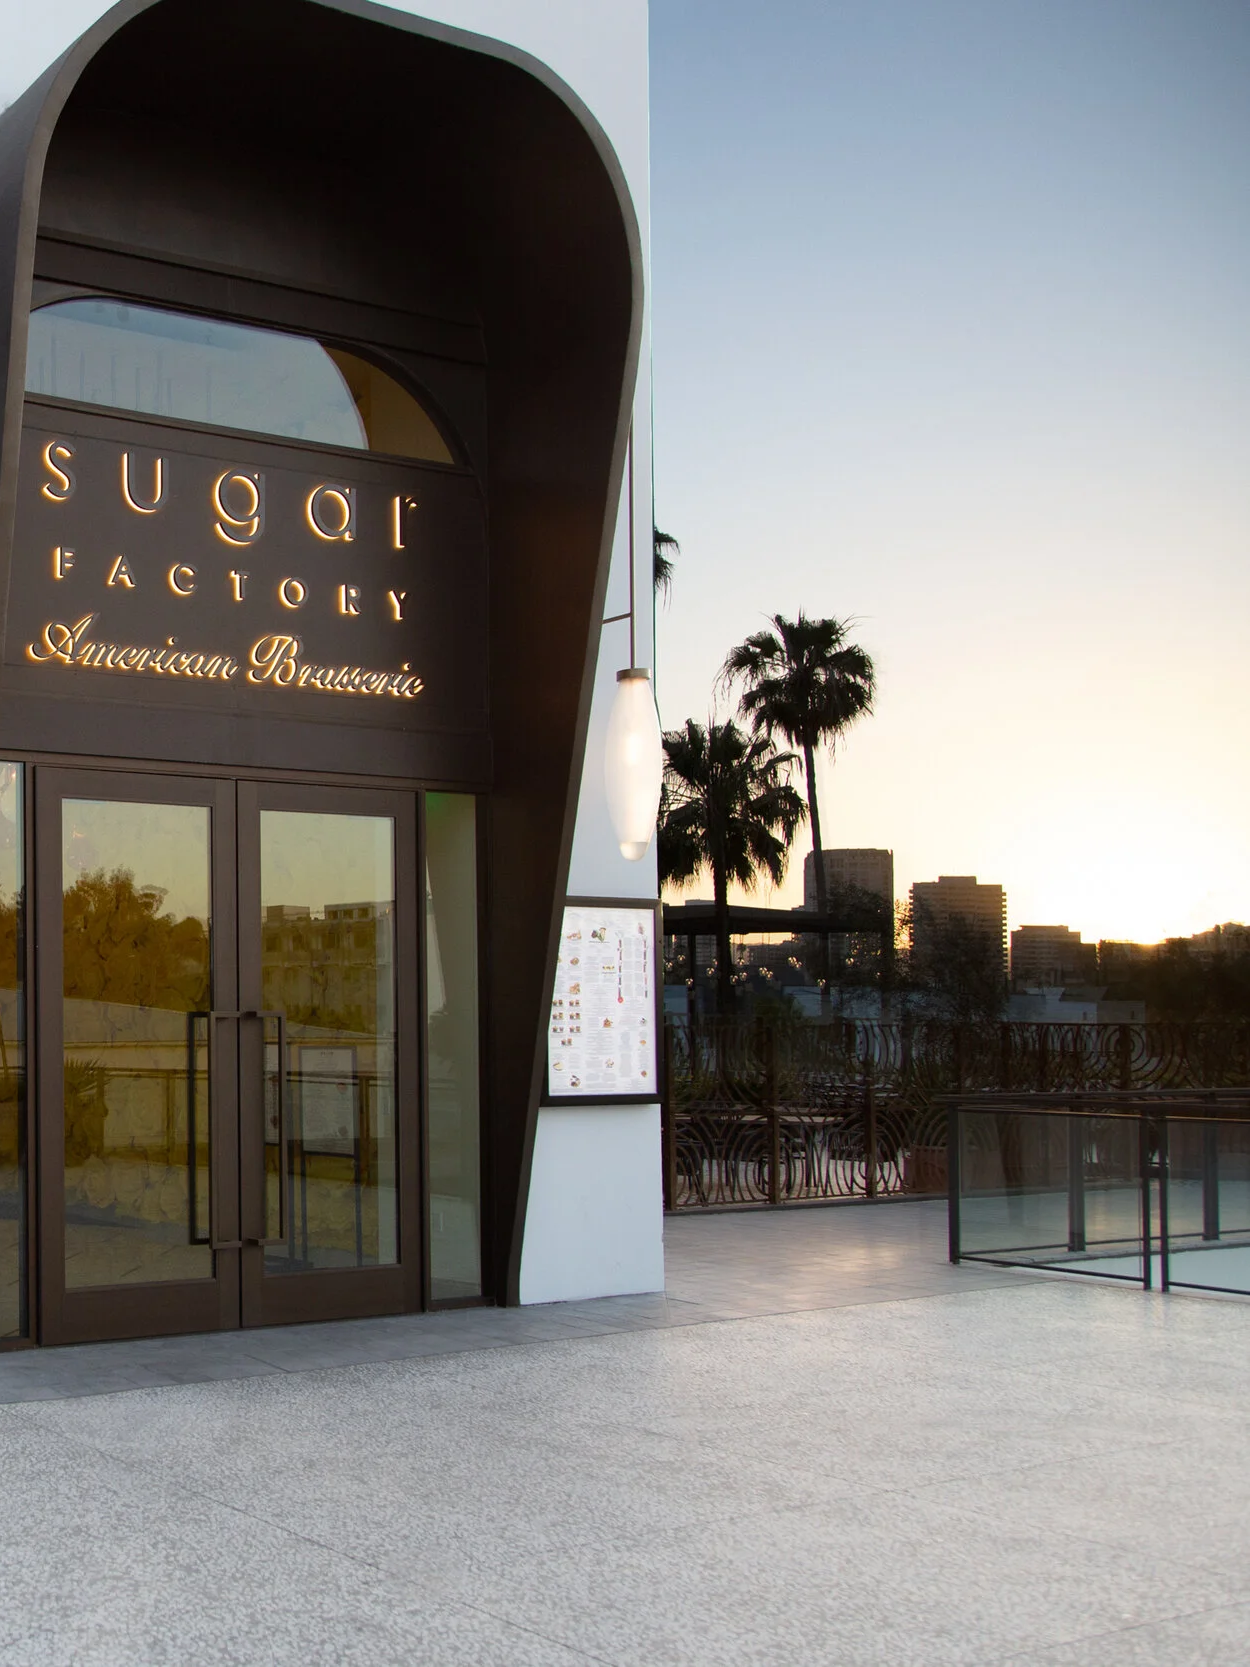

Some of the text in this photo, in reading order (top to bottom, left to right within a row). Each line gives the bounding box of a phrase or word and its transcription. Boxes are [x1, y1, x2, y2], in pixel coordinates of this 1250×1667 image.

[54, 546, 410, 621] FACTORY
[28, 612, 425, 698] American Brasserie
